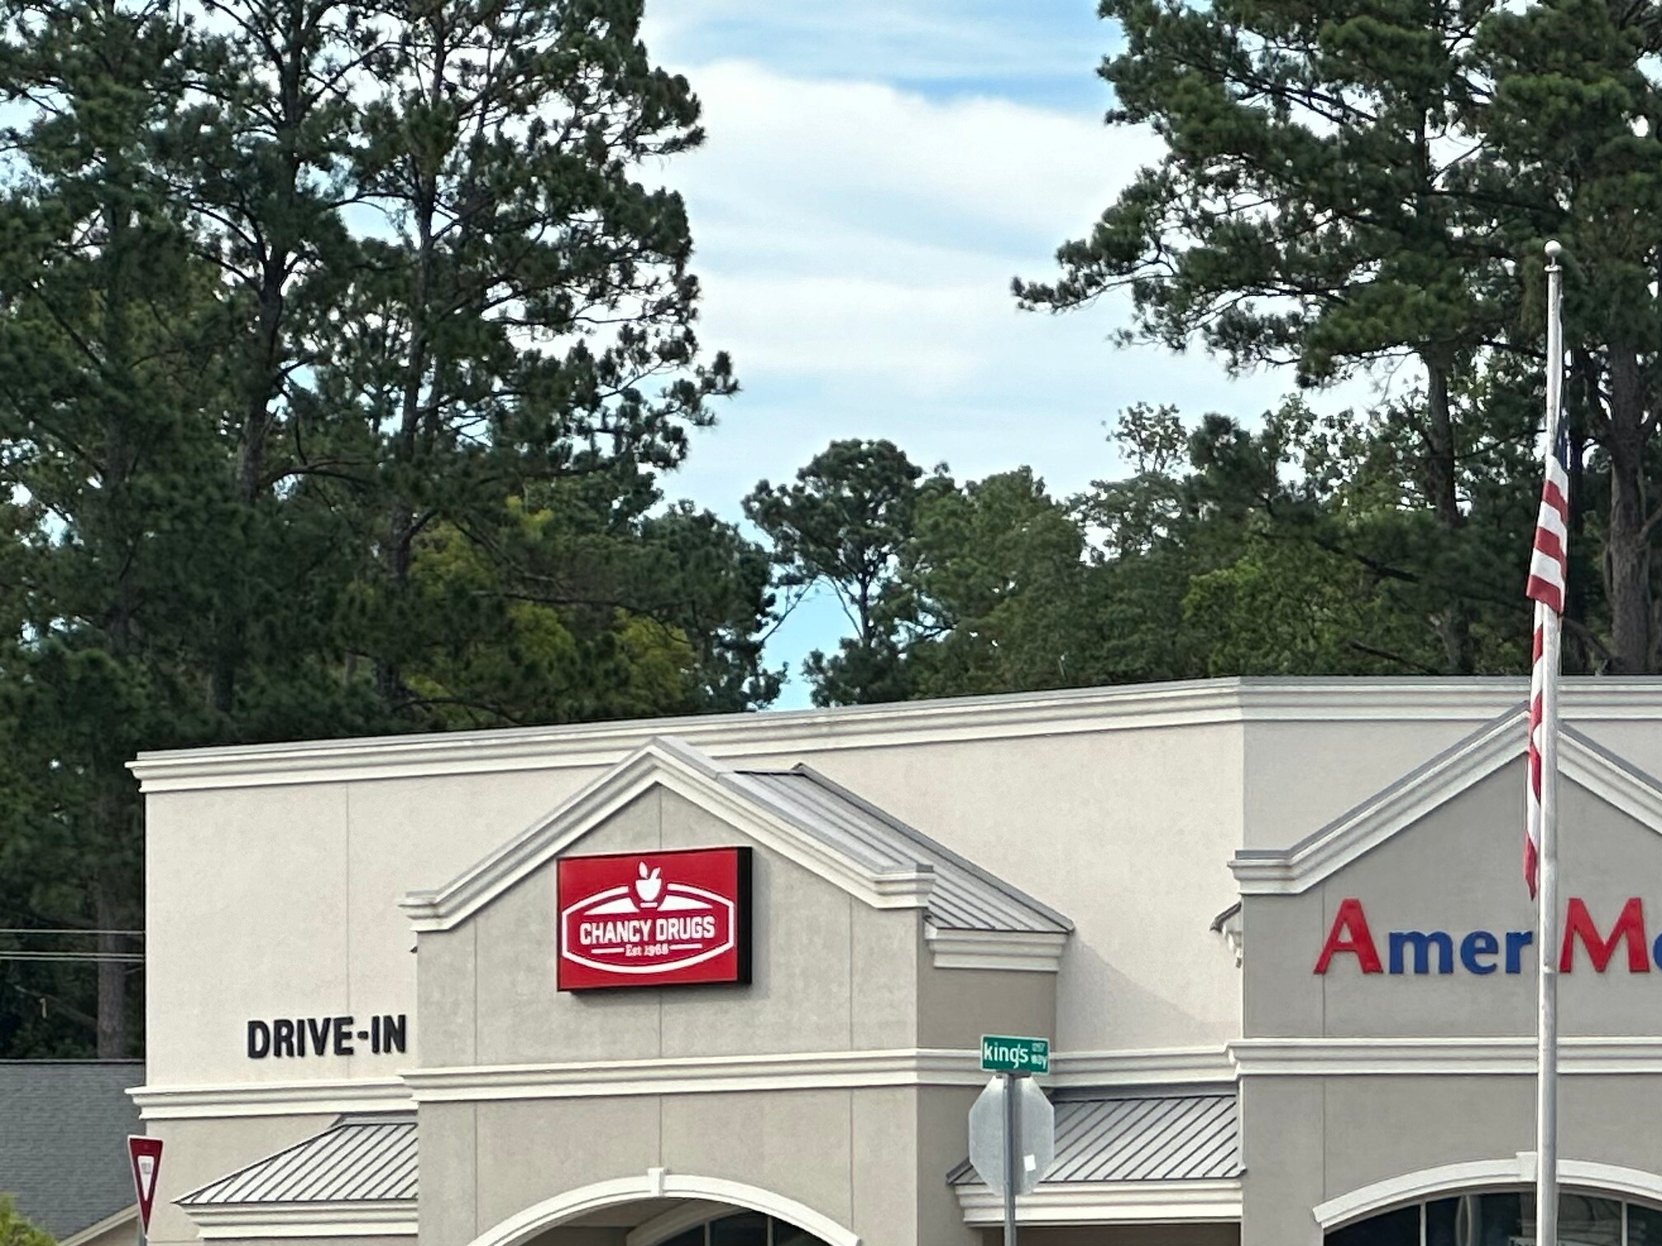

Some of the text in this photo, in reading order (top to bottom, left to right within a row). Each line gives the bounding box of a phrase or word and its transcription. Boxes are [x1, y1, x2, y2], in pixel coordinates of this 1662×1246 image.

[579, 915, 716, 946] CHANCY DRUGS
[624, 943, 642, 957] Est
[247, 1014, 407, 1059] DRIVE-IN
[984, 1041, 1029, 1069] king's
